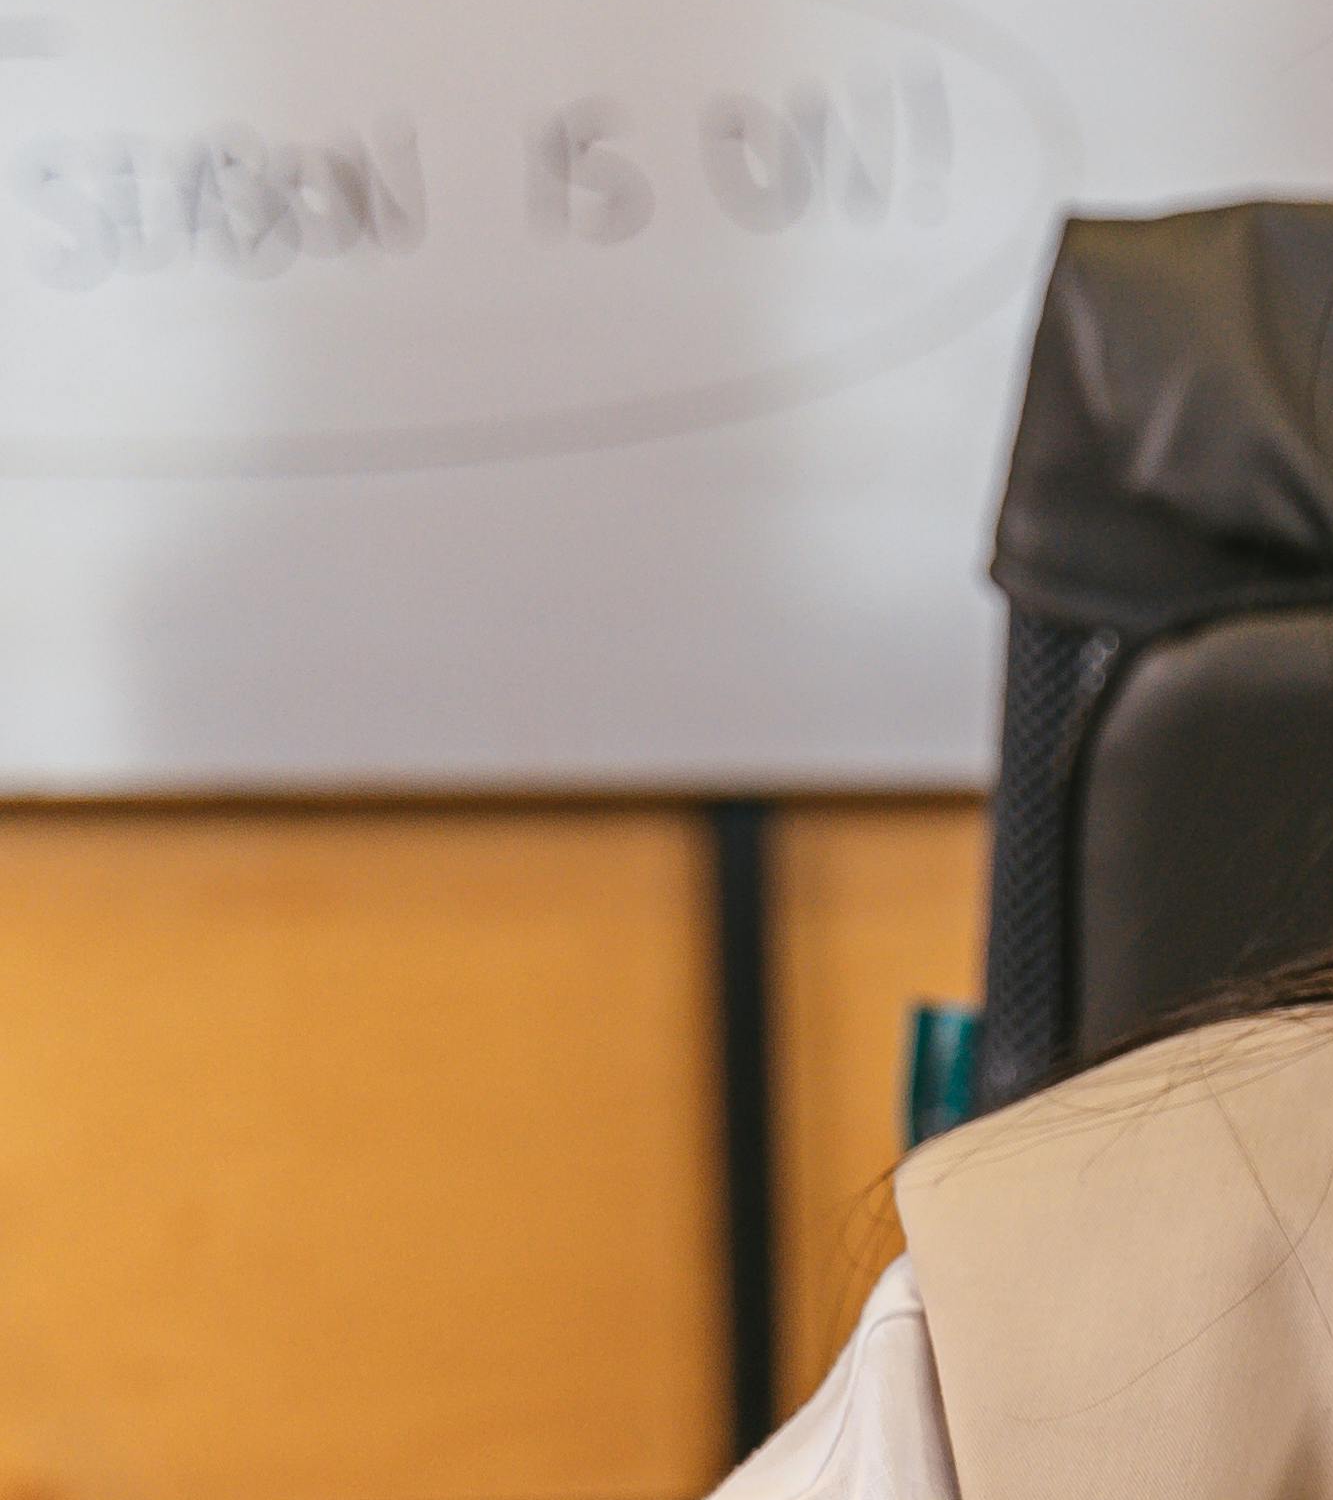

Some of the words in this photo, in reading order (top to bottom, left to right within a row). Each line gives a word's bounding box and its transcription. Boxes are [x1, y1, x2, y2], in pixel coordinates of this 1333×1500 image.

[14, 114, 424, 285] SEASON
[528, 100, 648, 242] IS
[704, 52, 954, 232] ON!
